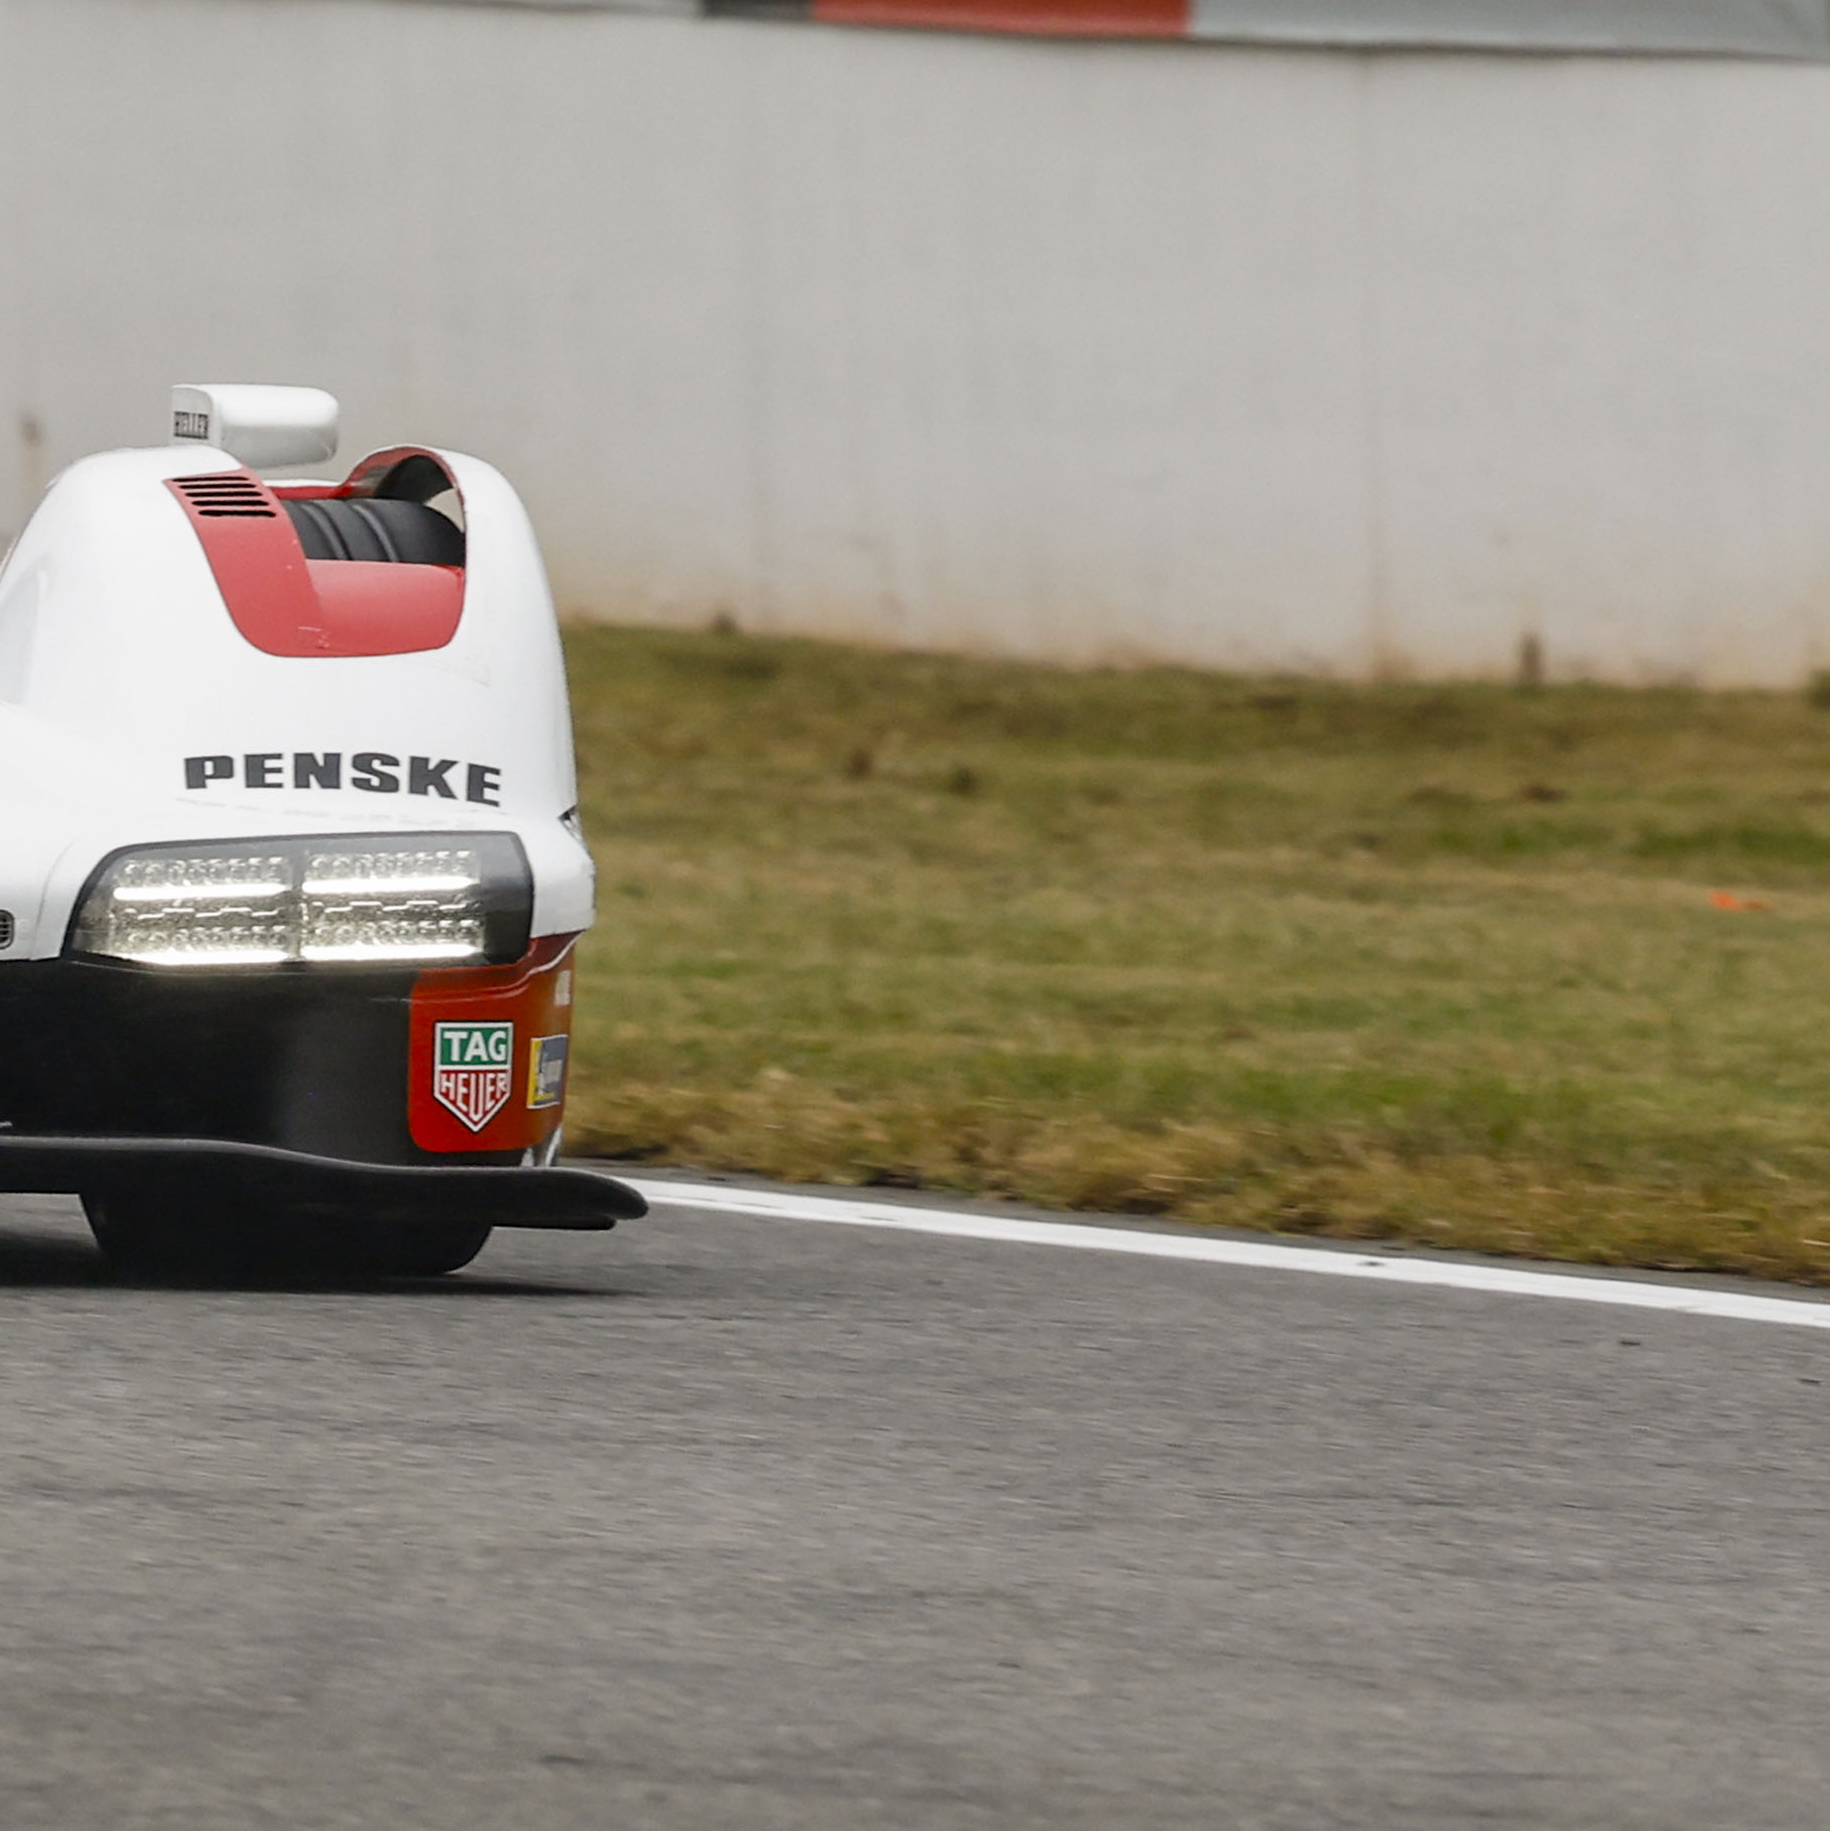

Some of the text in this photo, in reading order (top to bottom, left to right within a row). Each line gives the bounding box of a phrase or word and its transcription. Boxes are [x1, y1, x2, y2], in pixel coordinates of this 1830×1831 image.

[182, 751, 503, 808] PENSKE
[442, 1030, 507, 1063] TAG
[440, 1072, 509, 1123] HEUER
